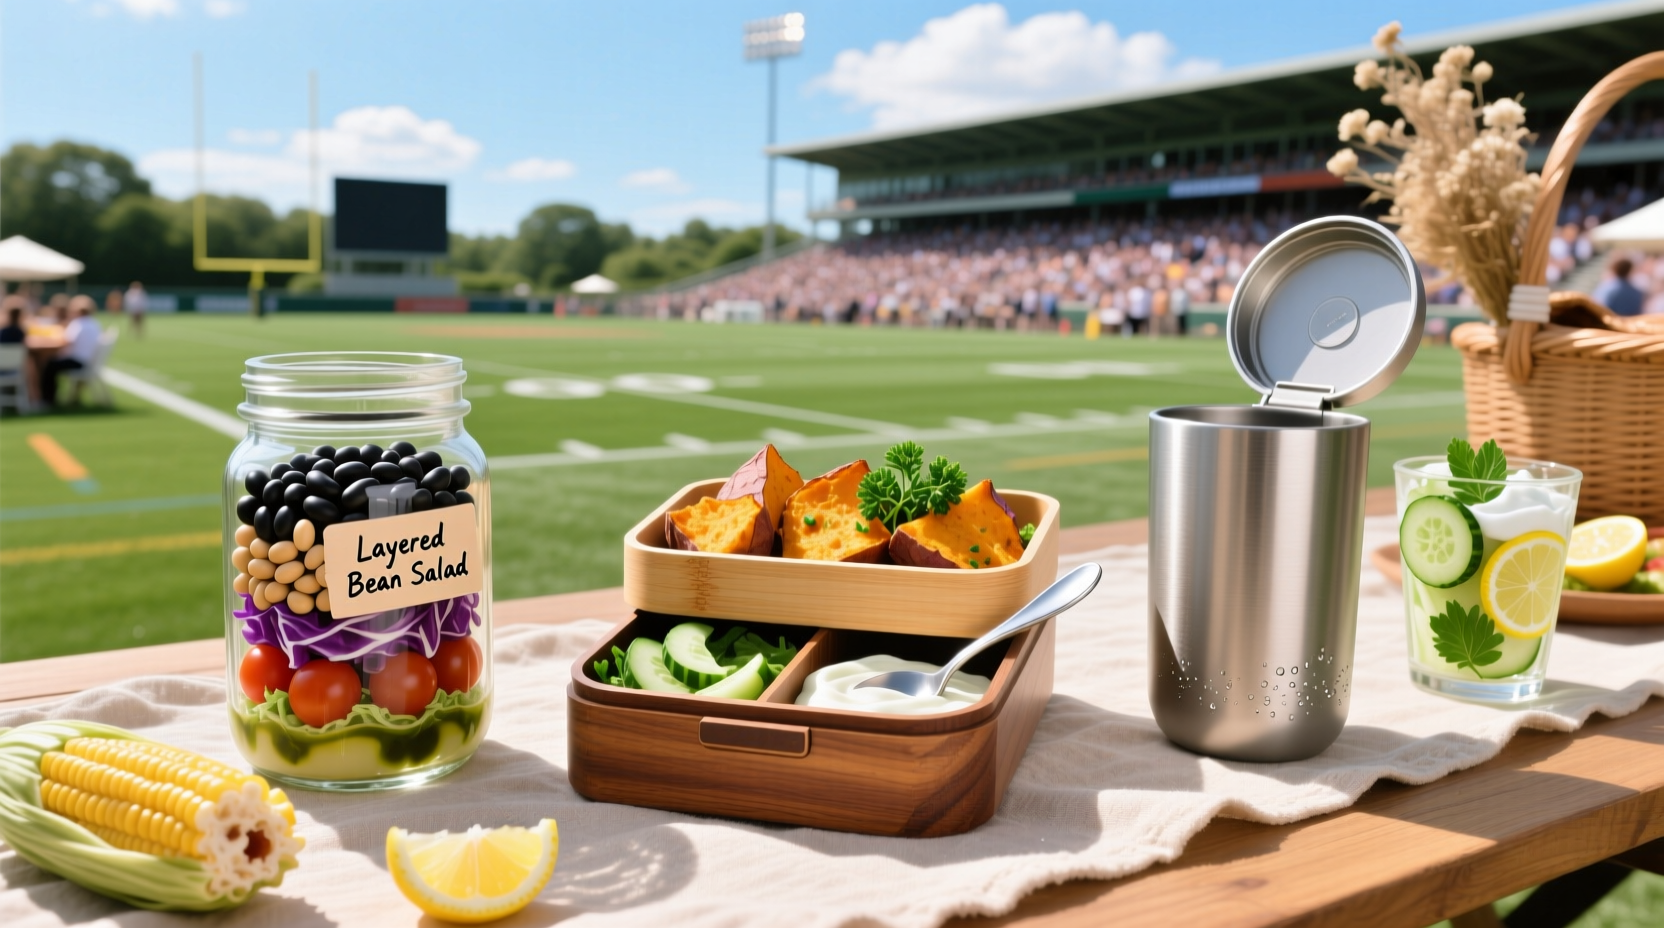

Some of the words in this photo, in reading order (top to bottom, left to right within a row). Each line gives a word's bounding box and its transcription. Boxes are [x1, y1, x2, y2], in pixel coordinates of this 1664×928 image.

[357, 521, 445, 570] Layered
[347, 571, 402, 598] Bean
[411, 551, 468, 585] Salad
